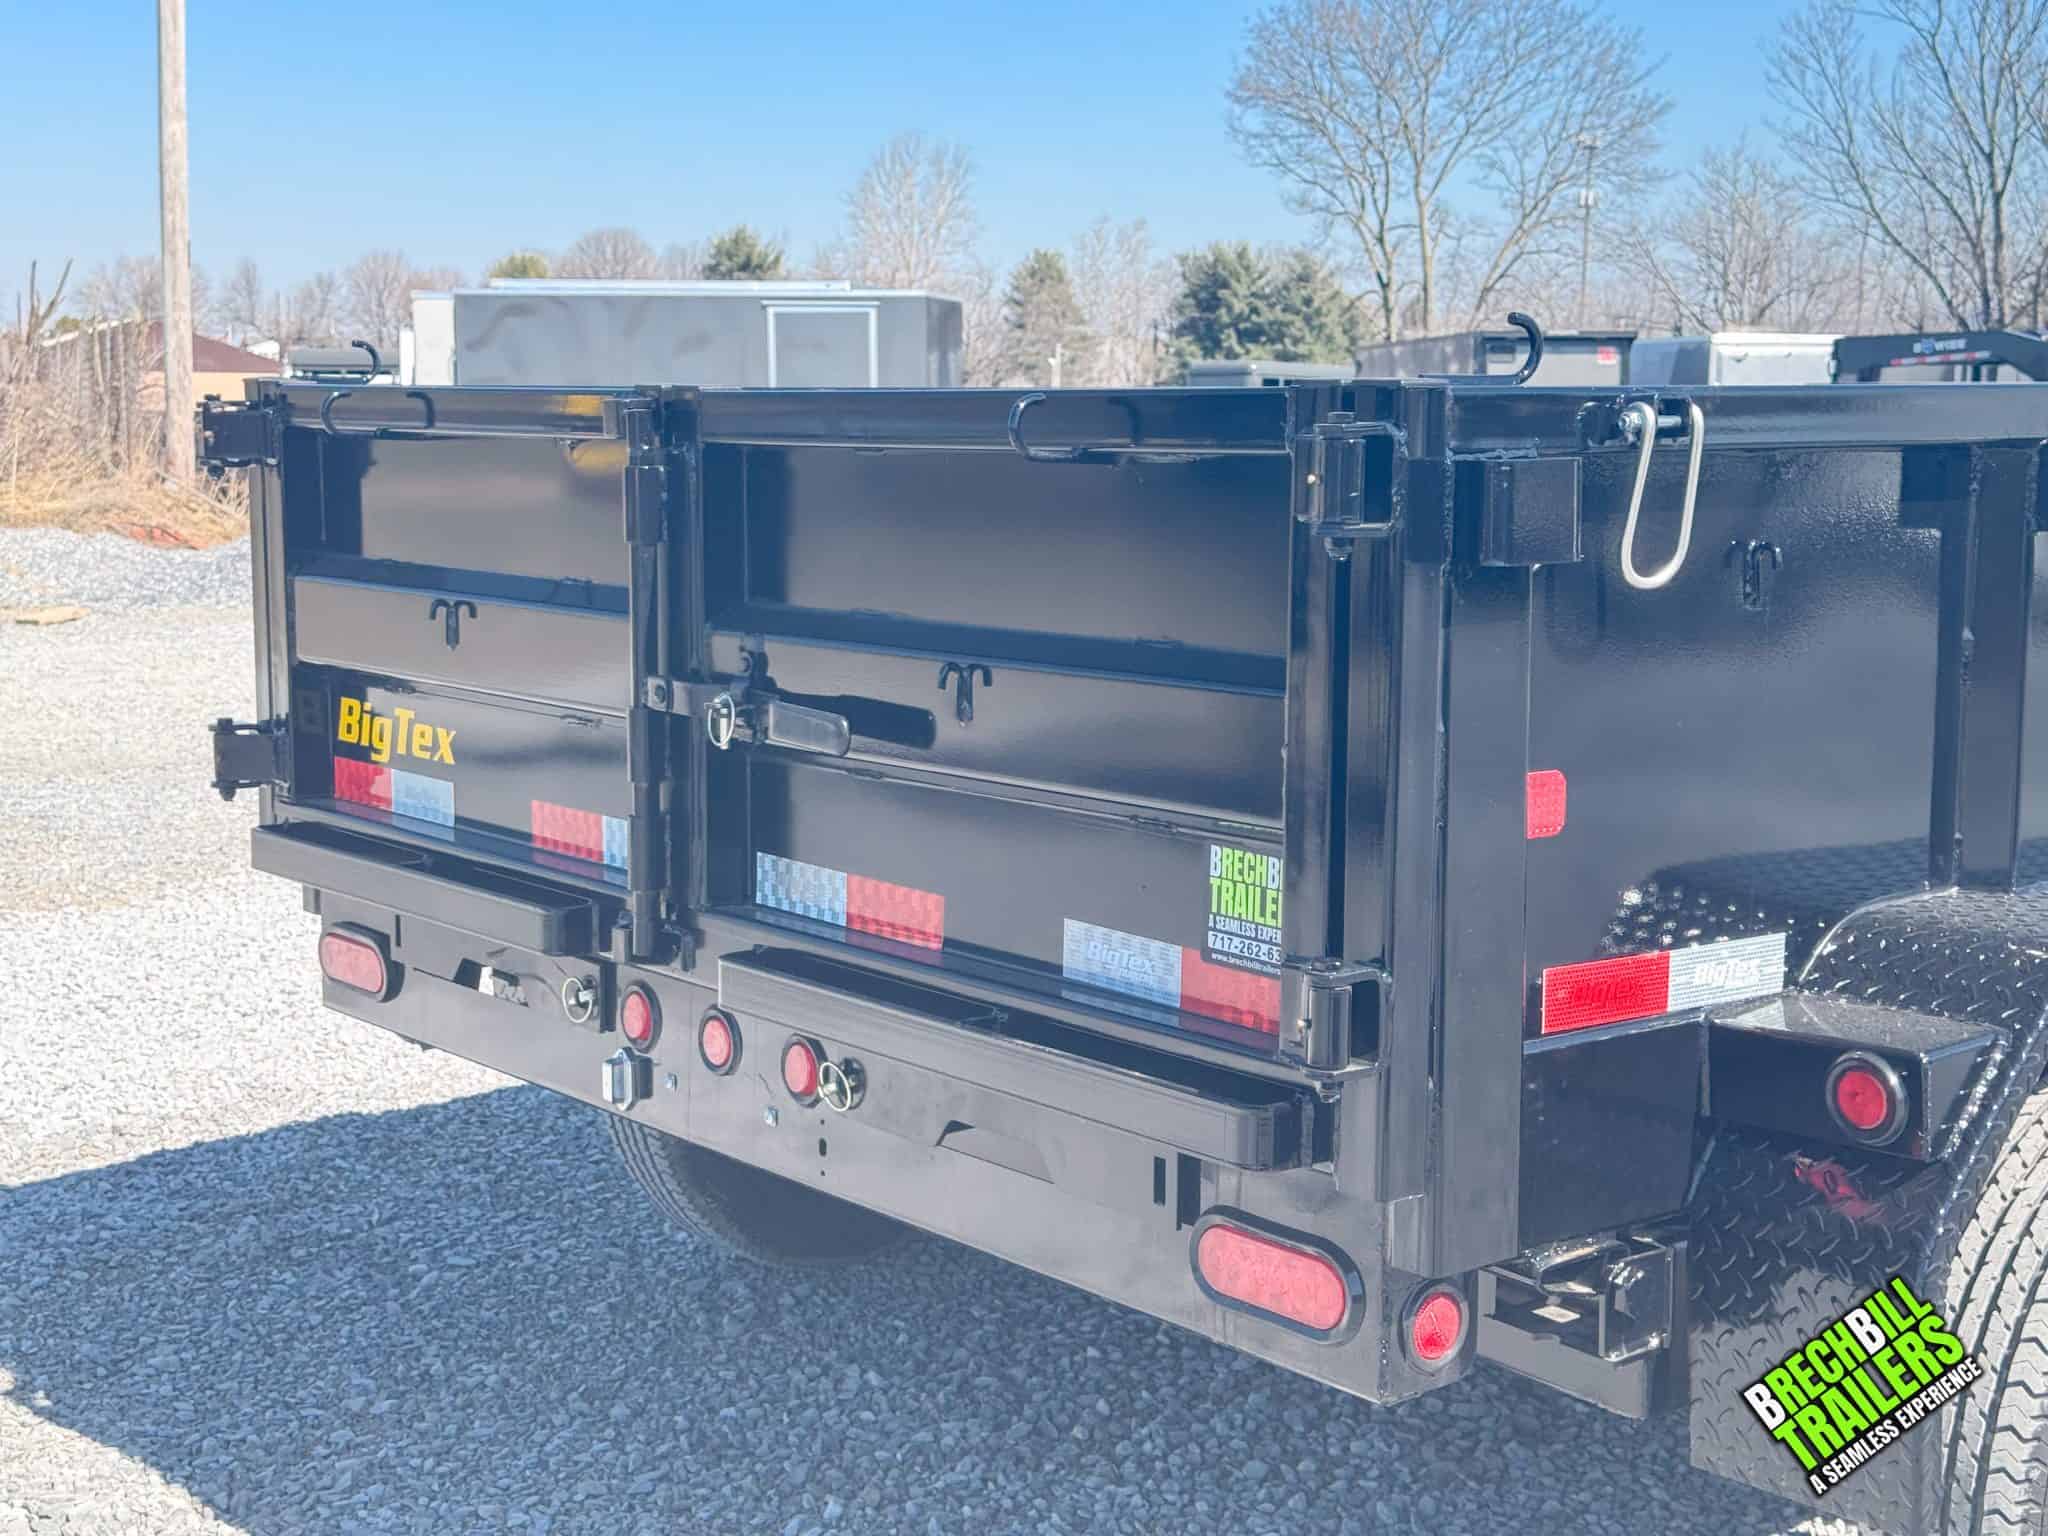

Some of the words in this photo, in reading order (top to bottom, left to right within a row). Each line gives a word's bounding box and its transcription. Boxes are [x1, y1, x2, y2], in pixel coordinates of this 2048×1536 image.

[338, 696, 456, 765] BigTex
[1208, 913, 1215, 930] A
[1215, 914, 1257, 939] SEAMLESS
[1211, 933, 1281, 963] 717-262-63
